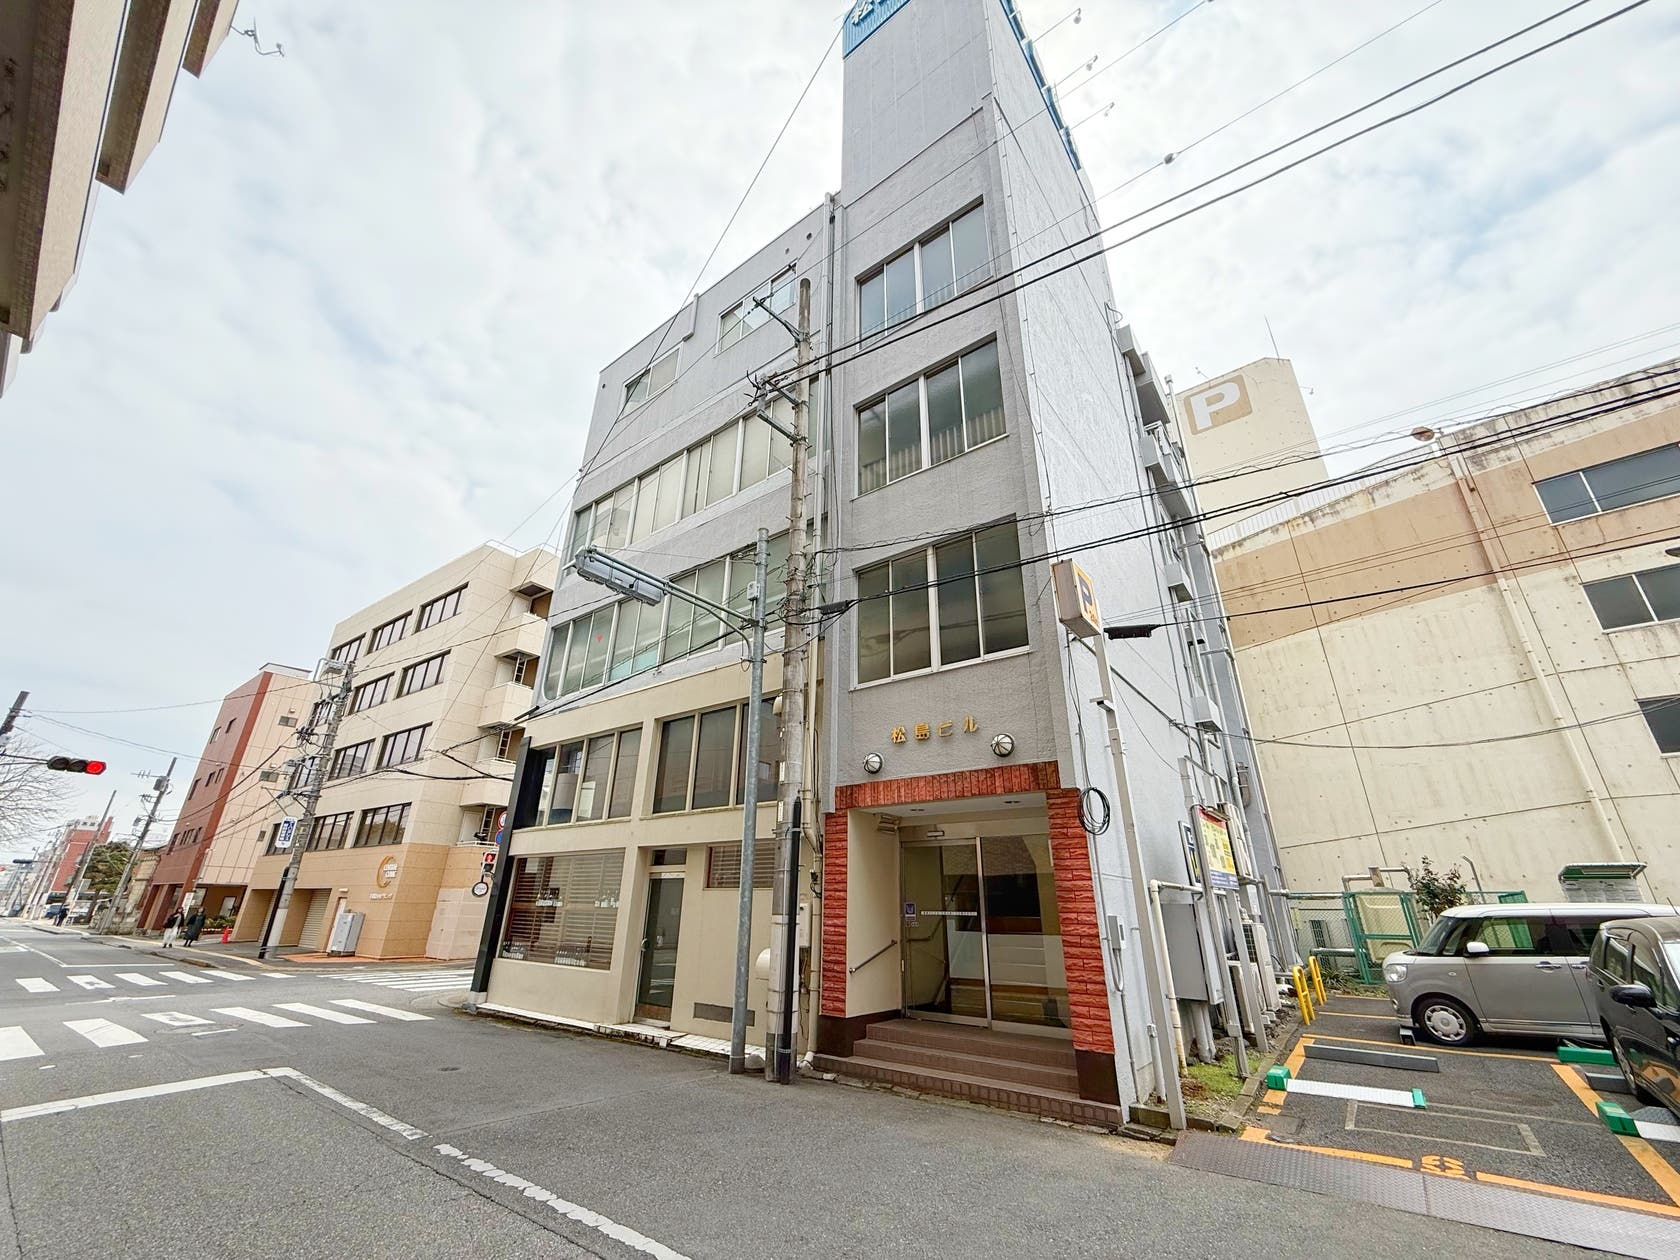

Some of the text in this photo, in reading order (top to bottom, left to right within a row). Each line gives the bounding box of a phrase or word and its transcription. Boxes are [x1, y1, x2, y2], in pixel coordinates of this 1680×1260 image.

[1190, 381, 1241, 431] P
[890, 715, 979, 745] 松島ビル
